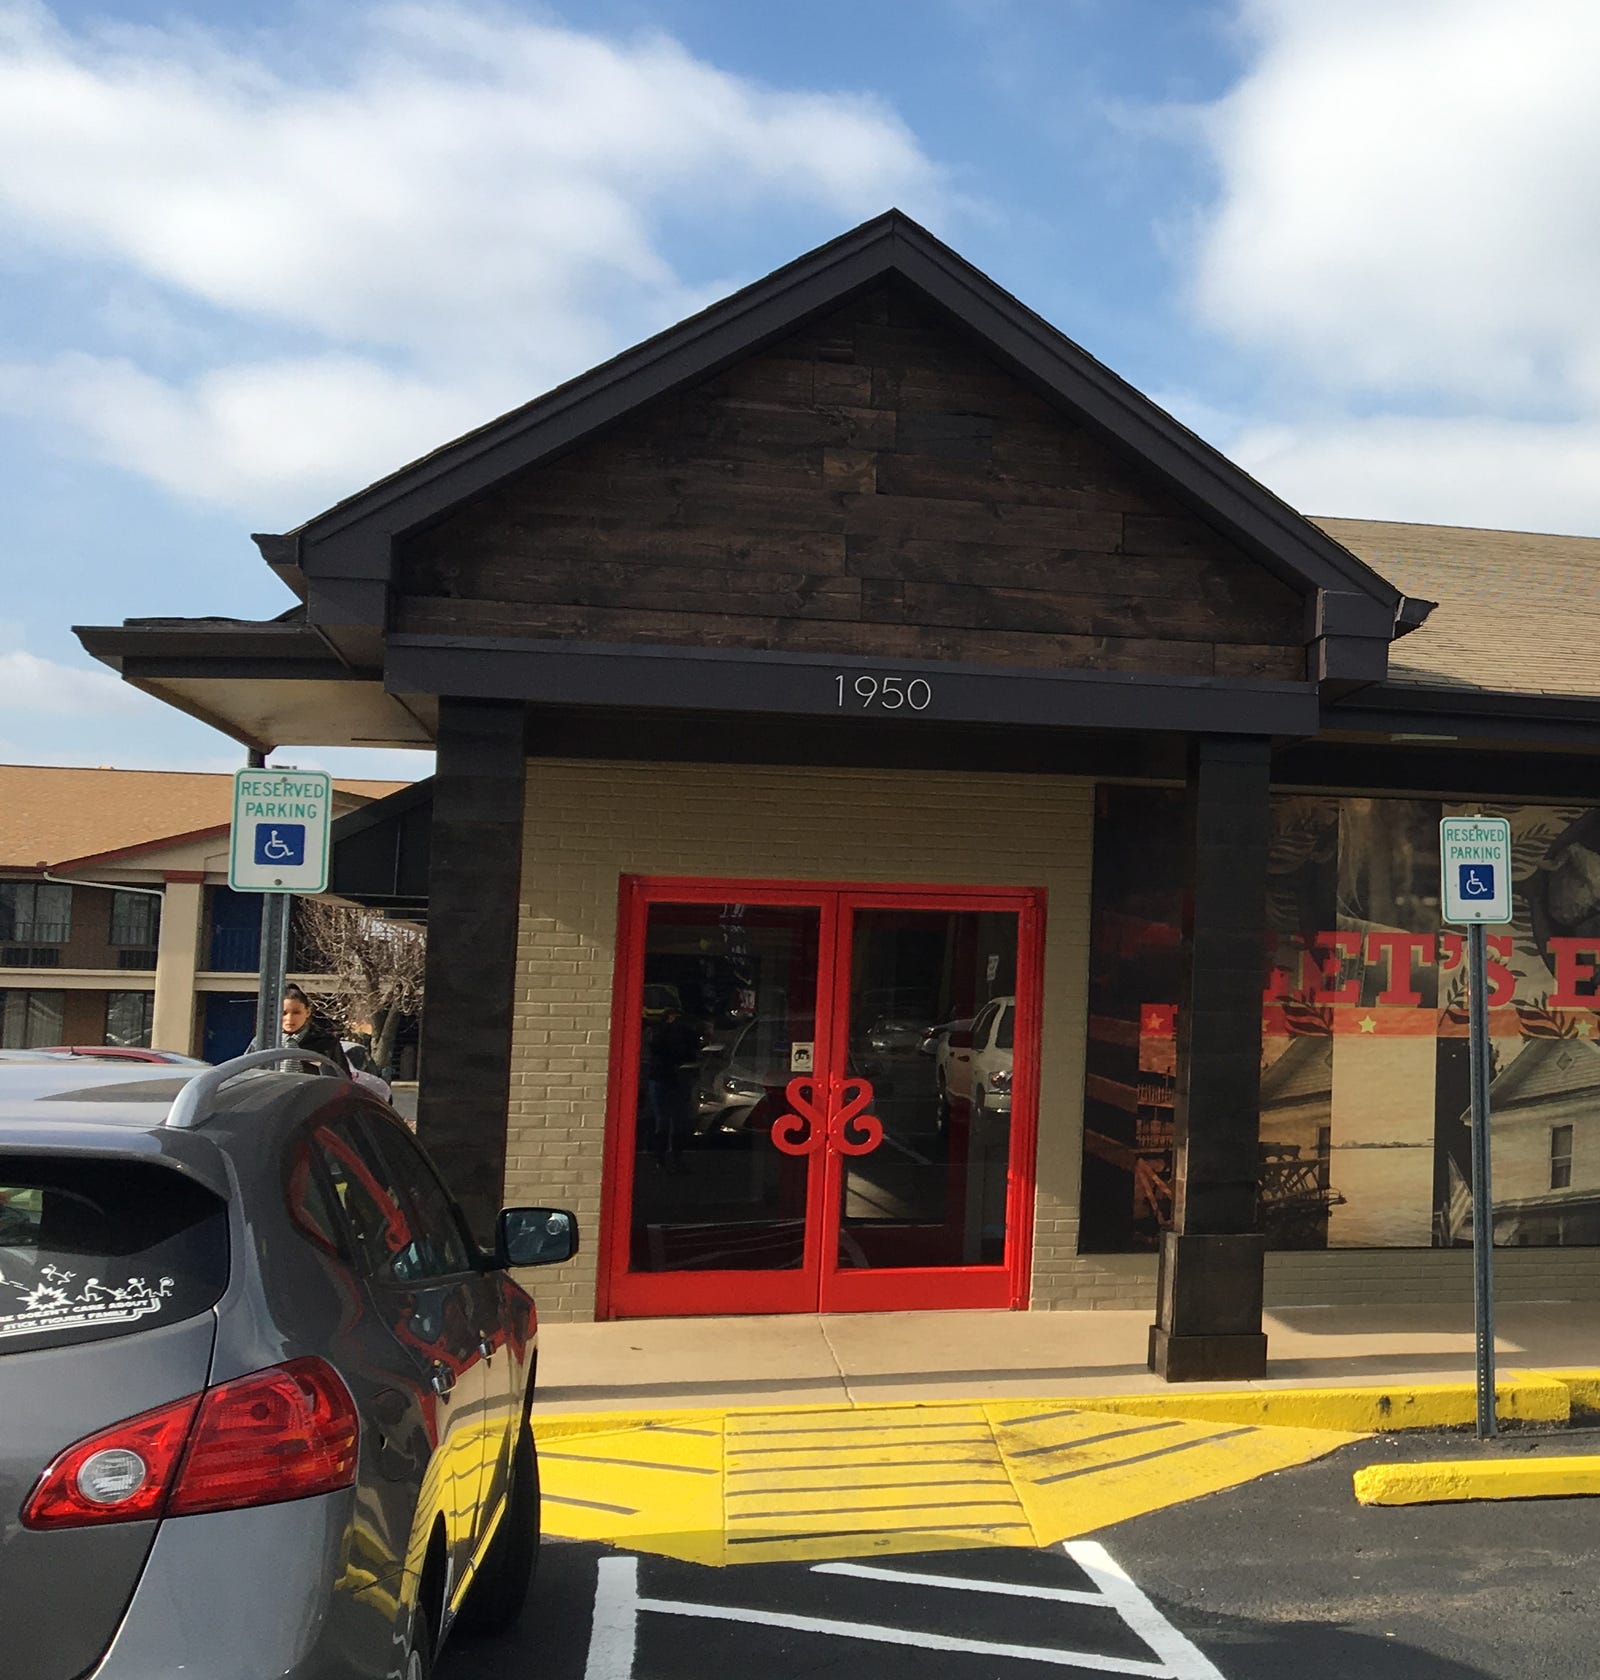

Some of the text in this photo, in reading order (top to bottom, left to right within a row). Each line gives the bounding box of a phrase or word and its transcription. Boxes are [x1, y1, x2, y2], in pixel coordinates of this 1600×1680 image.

[835, 675, 931, 710] 1950
[241, 781, 324, 798] RESERVED
[245, 802, 317, 819] PARKING
[1446, 828, 1505, 842] RESERVED
[1450, 846, 1501, 860] PARKING
[109, 1300, 148, 1308] ABOUT
[3, 1319, 39, 1330] STICK
